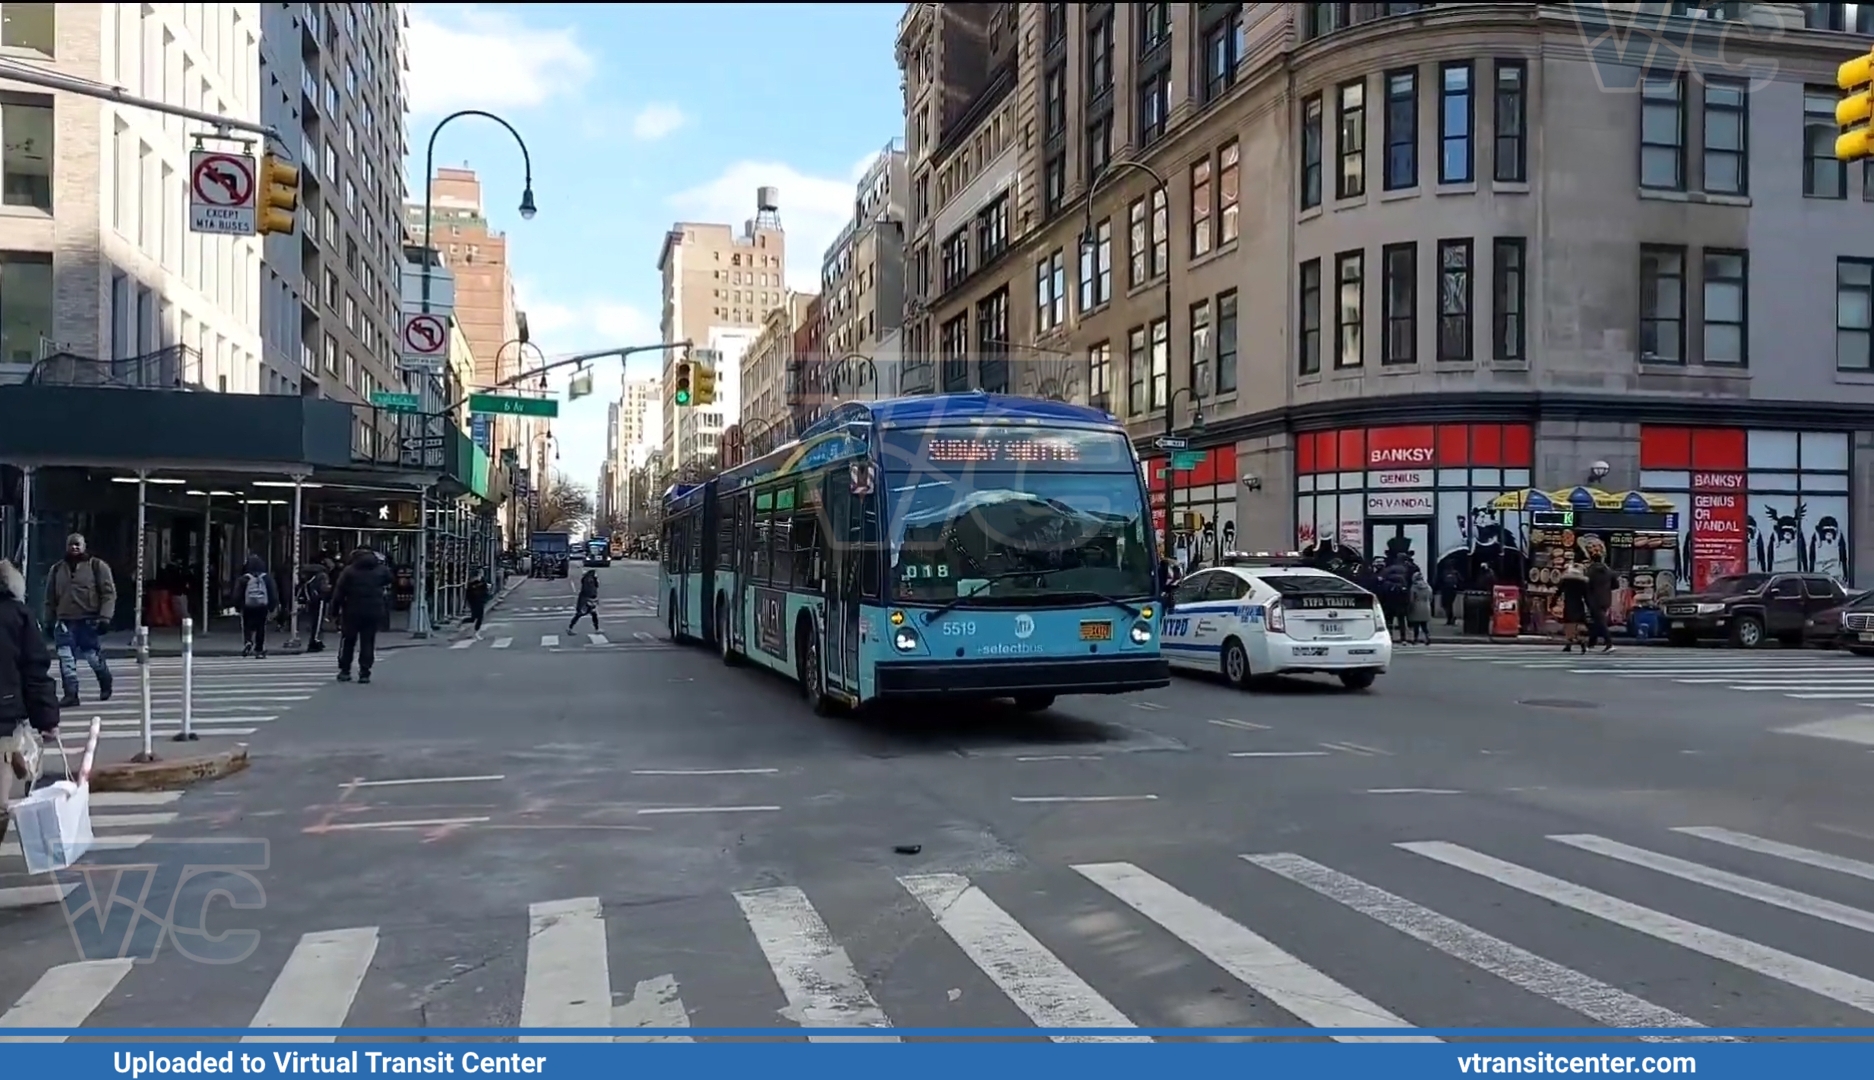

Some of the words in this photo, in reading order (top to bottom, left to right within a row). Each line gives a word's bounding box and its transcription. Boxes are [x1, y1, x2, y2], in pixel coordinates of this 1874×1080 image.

[206, 208, 239, 220] EXCEPT
[196, 218, 215, 229] MTA
[219, 220, 250, 232] BUSES
[504, 401, 511, 411] 6
[929, 439, 1000, 460] SUBWAY
[1371, 448, 1434, 463] BANKSY
[1380, 473, 1420, 484] GENIUS
[1694, 474, 1743, 487] BANKSY
[1368, 498, 1383, 508] OR
[1386, 498, 1432, 508] VANDAL
[1695, 496, 1735, 508] GENIUS
[1695, 509, 1710, 520] OR
[1695, 520, 1740, 532] VANDAL
[1325, 597, 1356, 607] TRAFFIC
[942, 621, 977, 636] 5519
[1161, 617, 1189, 637] NYPD
